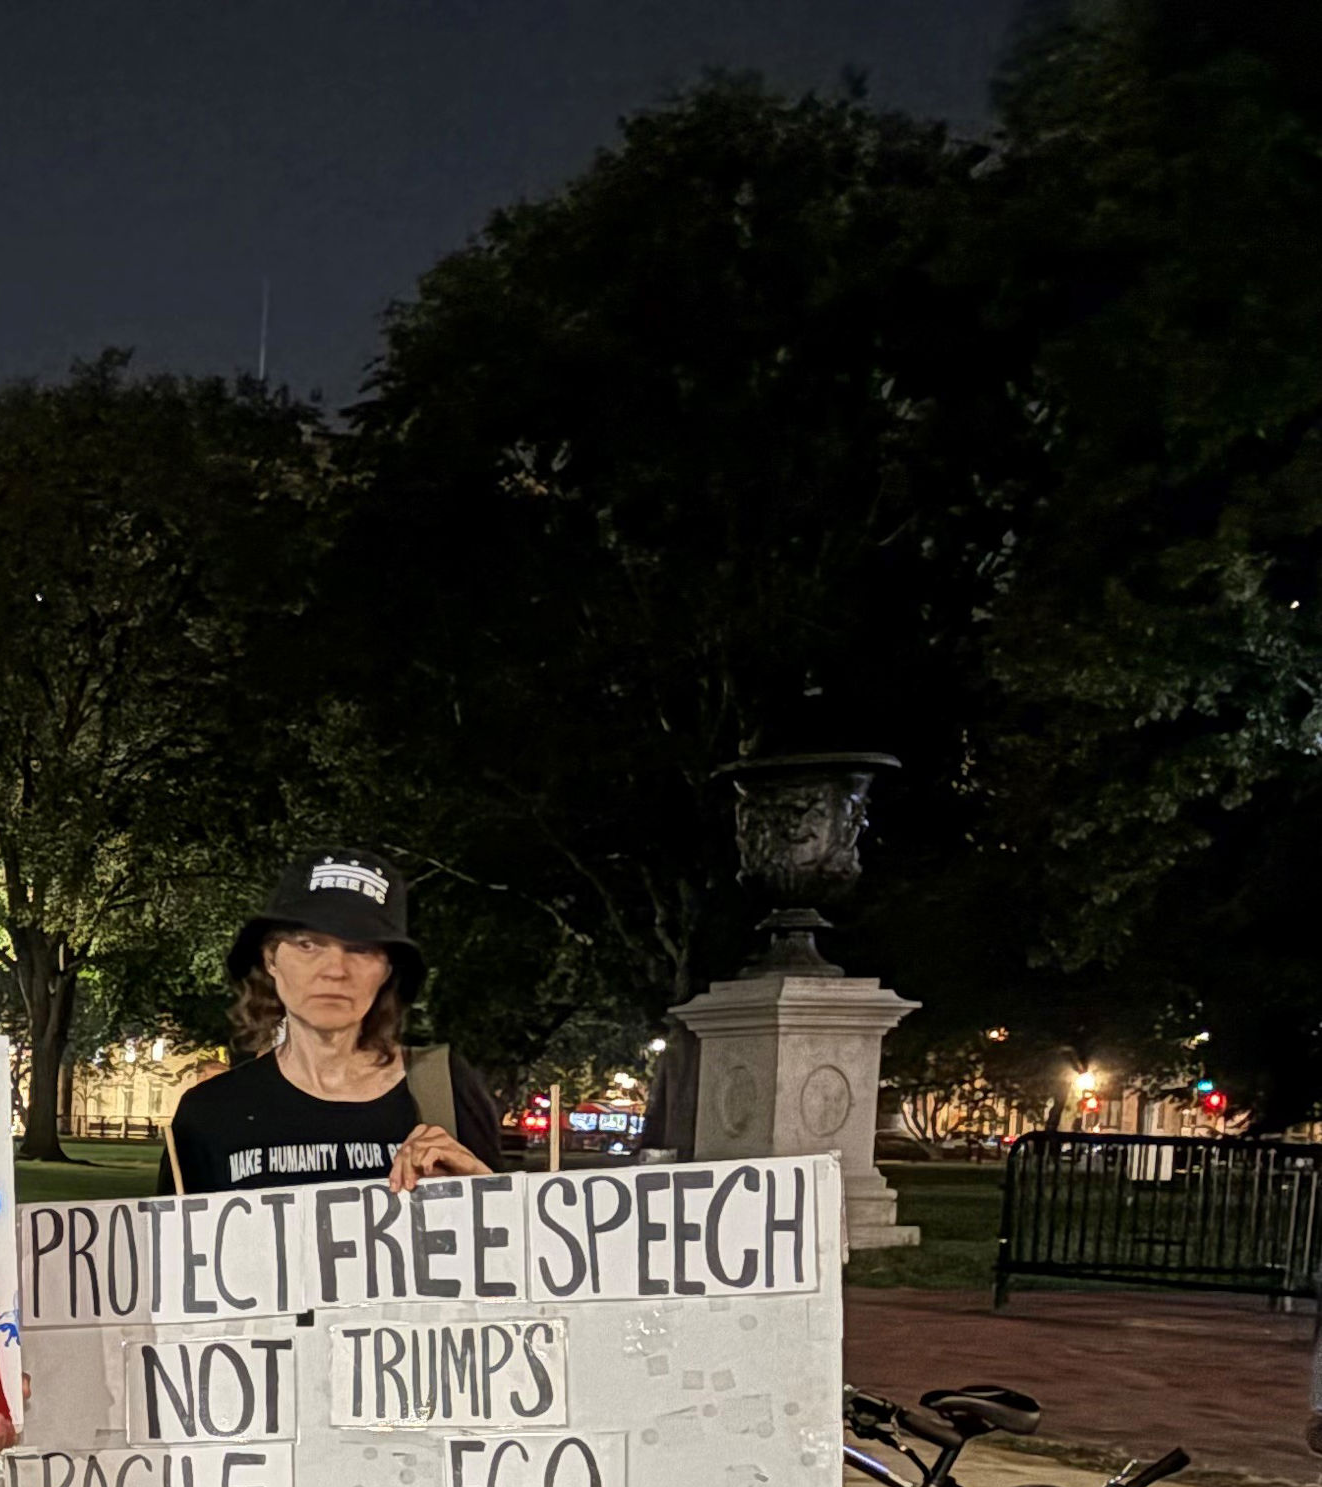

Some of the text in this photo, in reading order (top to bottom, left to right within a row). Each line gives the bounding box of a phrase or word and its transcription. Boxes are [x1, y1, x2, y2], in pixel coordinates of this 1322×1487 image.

[310, 877, 386, 904] FREE DC
[229, 1149, 262, 1183] MAKE
[269, 1143, 338, 1172] HUMANITY
[345, 1143, 383, 1169] YOUR
[31, 1164, 805, 1319] PROTECT FREE SPEECH
[142, 1323, 555, 1439] NOT TRUMP'S
